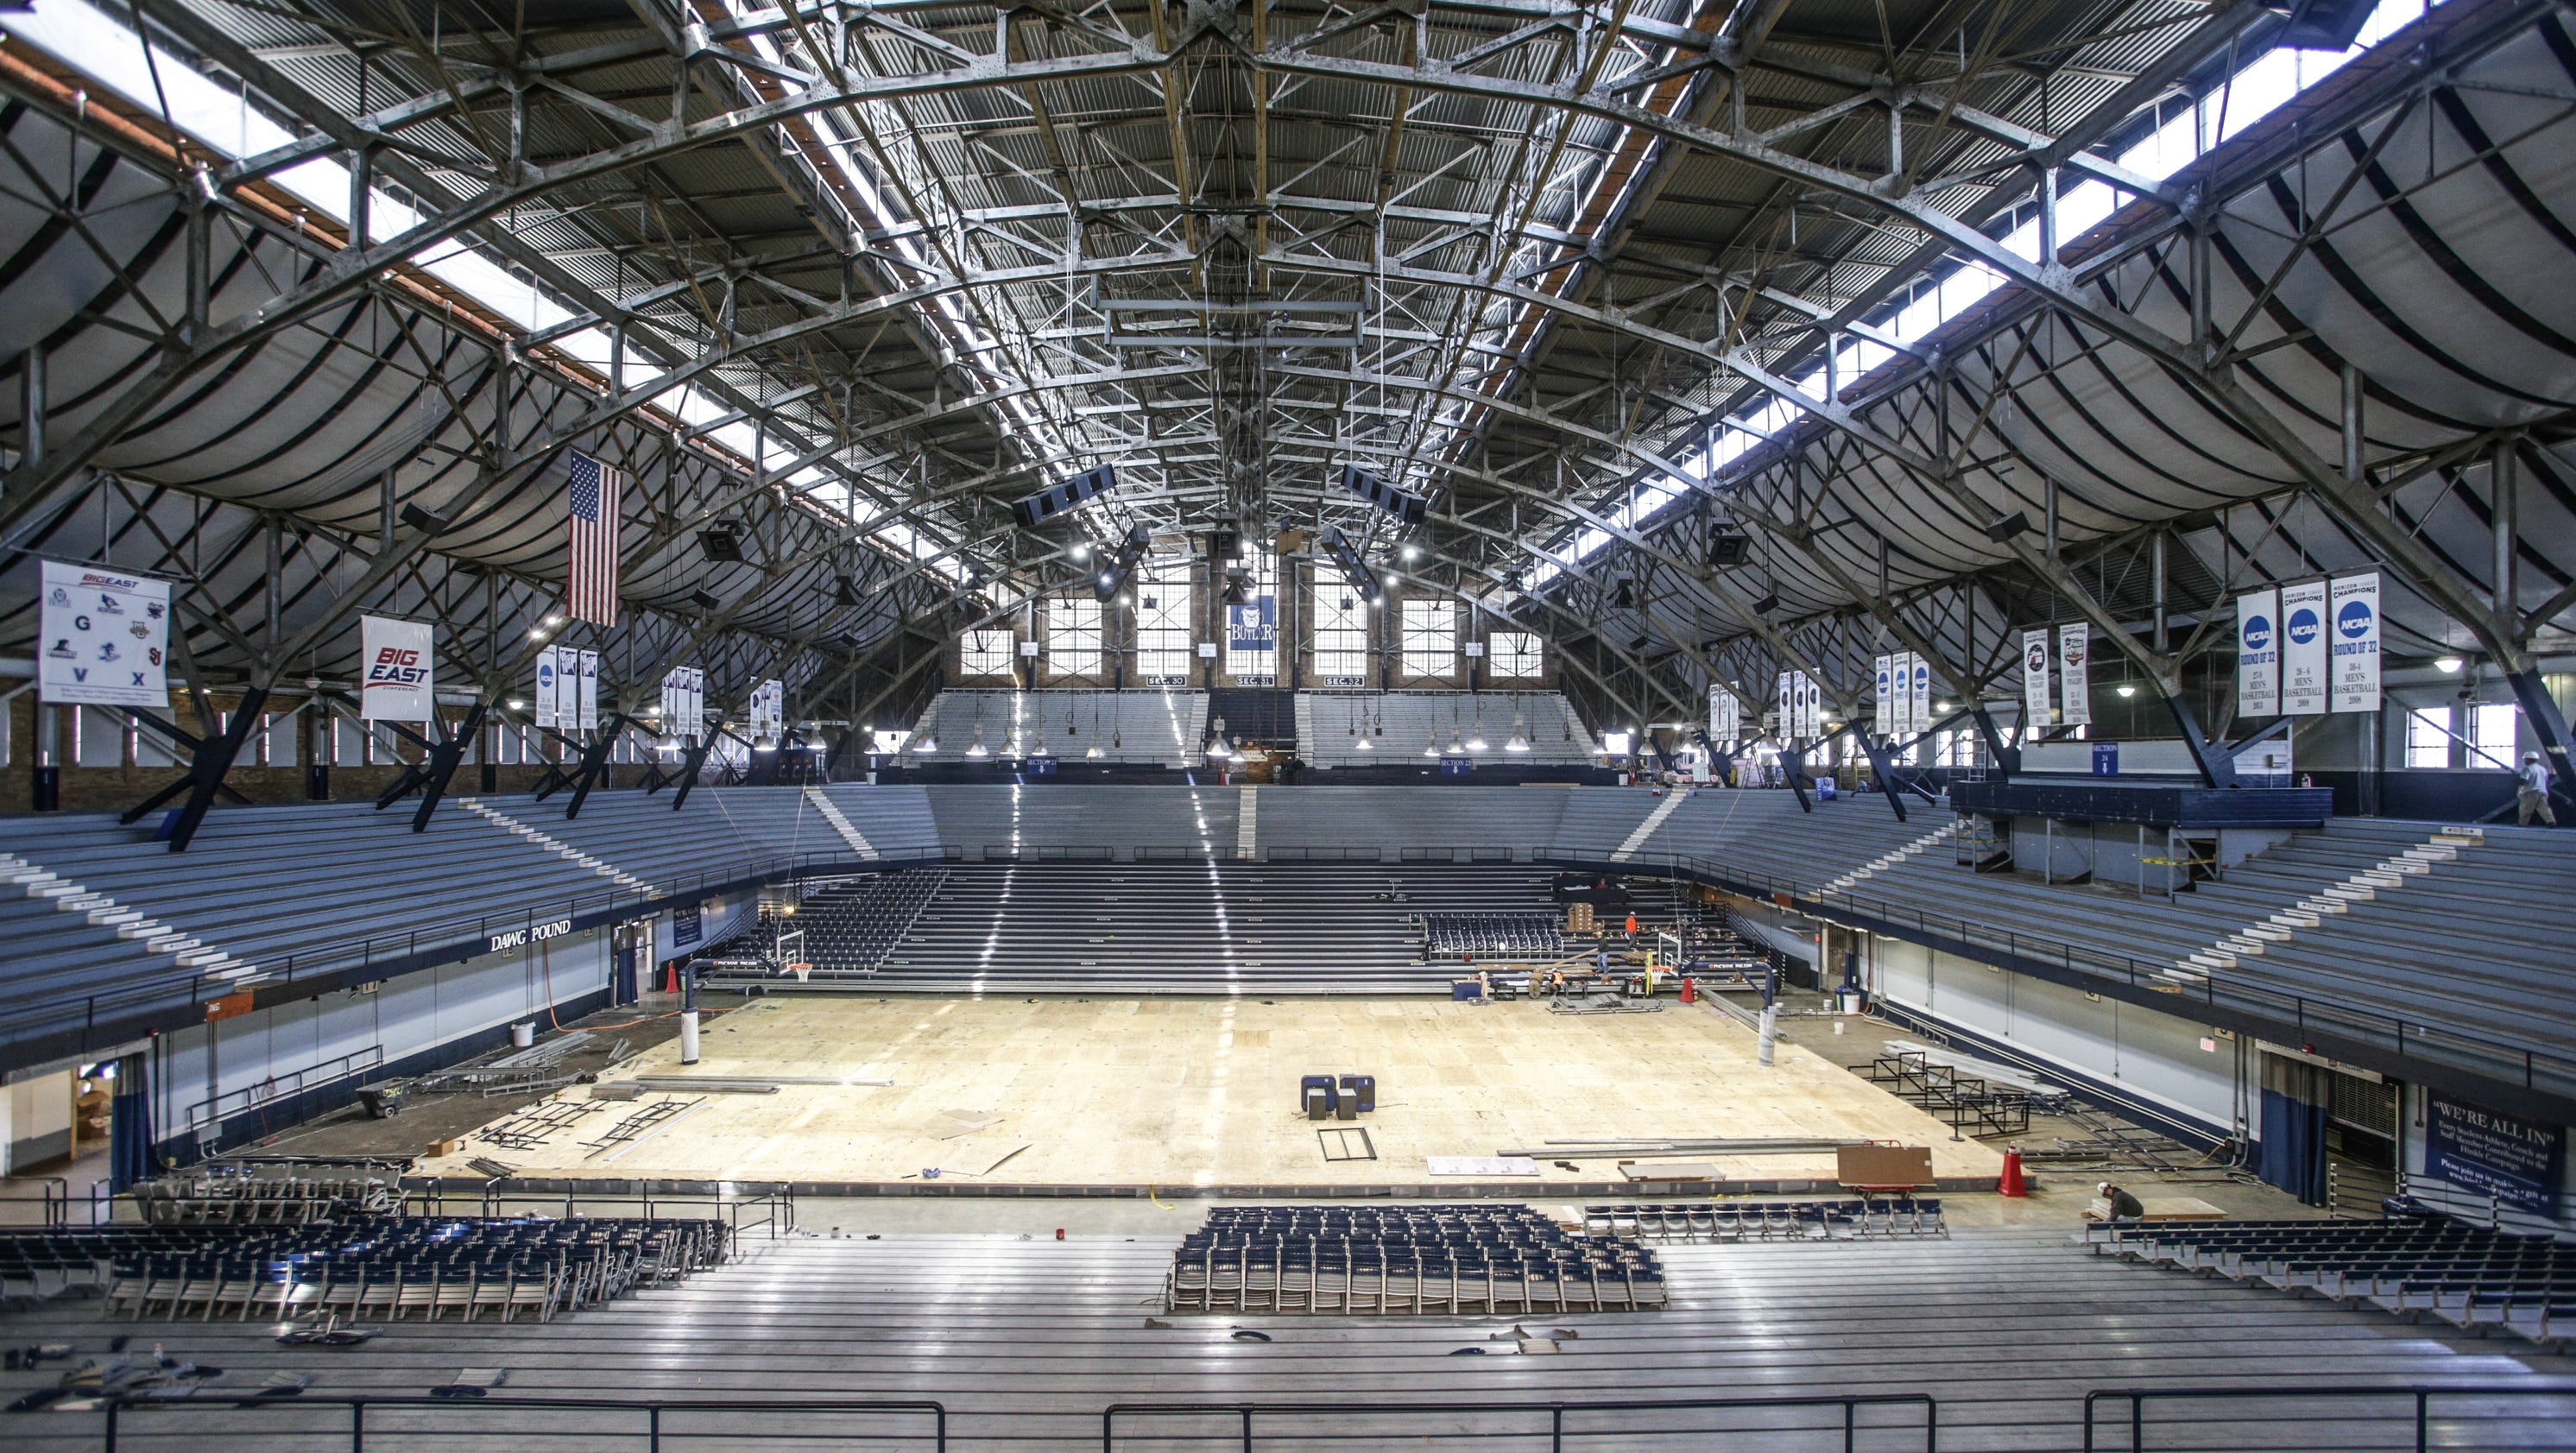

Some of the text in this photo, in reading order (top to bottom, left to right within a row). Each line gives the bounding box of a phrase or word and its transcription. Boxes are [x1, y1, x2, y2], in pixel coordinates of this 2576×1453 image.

[2333, 586, 2376, 599] CHAMPIONS
[2284, 595, 2323, 606] CHAMPIONS
[75, 615, 91, 631] G
[2291, 624, 2319, 636] NCAA
[2341, 617, 2372, 630] NCAA
[1231, 623, 1272, 641] BUTLER
[2246, 630, 2270, 642] NCAA
[2334, 641, 2377, 656] ROUND OF 32
[376, 648, 420, 666] BIG
[2240, 651, 2276, 665] ROUND OF 32
[73, 668, 88, 682] V
[132, 672, 145, 685] X
[369, 665, 429, 683] EAST
[2345, 673, 2365, 682] MEN'S
[2250, 680, 2266, 690] MEN'S
[2334, 683, 2377, 694] BASKETBALL
[2241, 690, 2276, 700] BASKETBALL
[2284, 687, 2323, 698] BASKETBALL
[490, 930, 526, 951] DAWG
[532, 919, 571, 942] POUND
[2491, 1117, 2522, 1139] ALL
[2439, 1120, 2455, 1134] Every
[2511, 1142, 2534, 1157] Coach
[2535, 1151, 2548, 1161] and
[2440, 1129, 2454, 1140] Staff
[2457, 1134, 2484, 1149] Member
[2484, 1144, 2524, 1163] Contributed
[2535, 1160, 2546, 1171] the
[2460, 1145, 2484, 1159] Hinkle
[2441, 1158, 2459, 1172] Please
[2460, 1166, 2473, 1174] join
[2485, 1173, 2491, 1183] in
[2541, 1194, 2548, 1203] at
